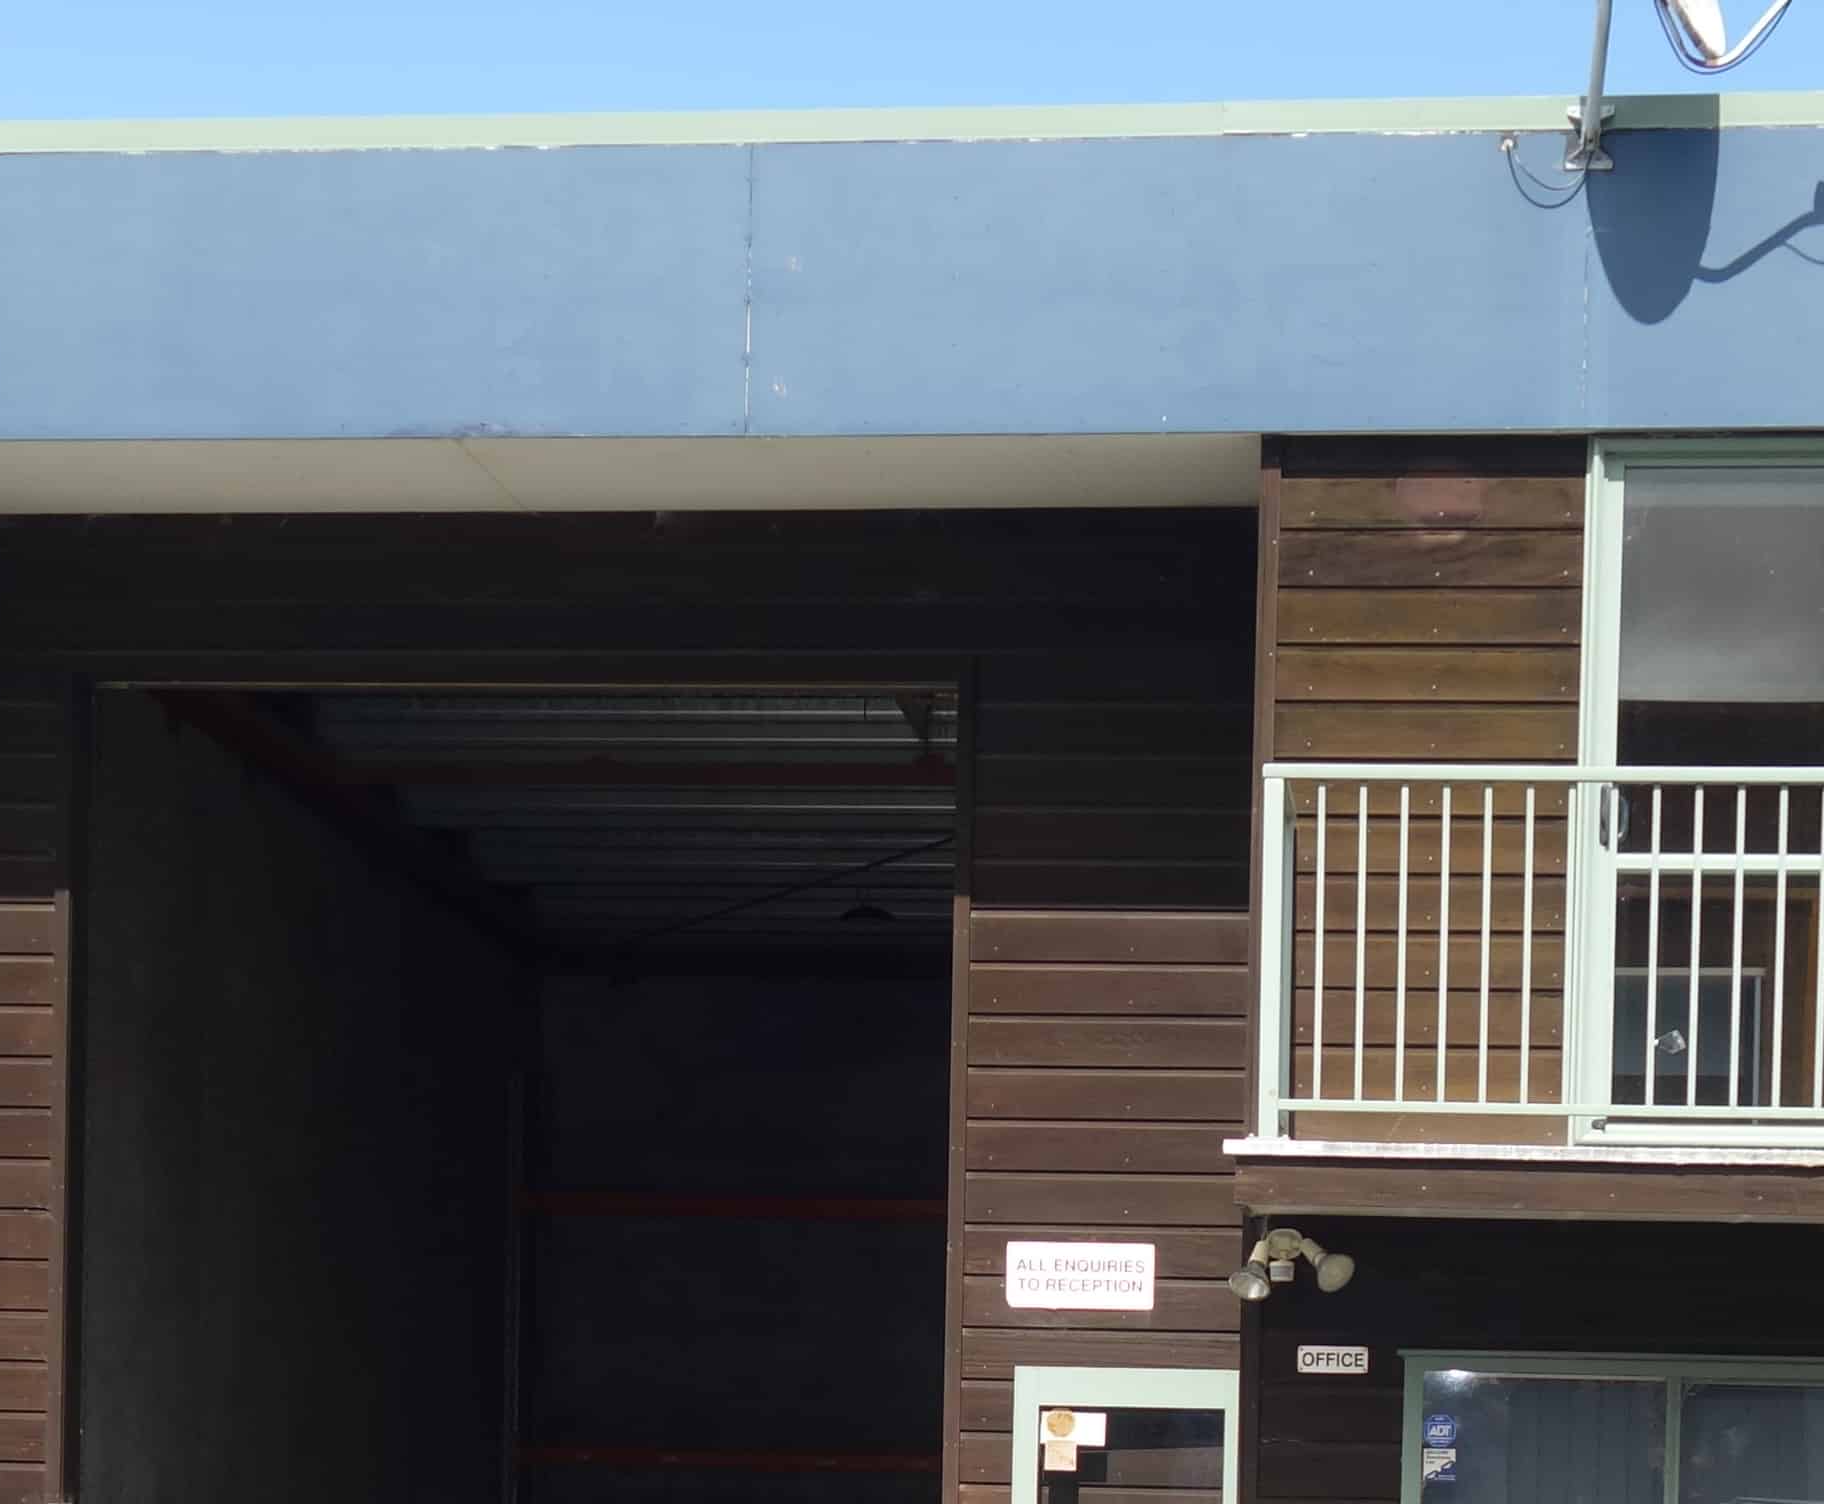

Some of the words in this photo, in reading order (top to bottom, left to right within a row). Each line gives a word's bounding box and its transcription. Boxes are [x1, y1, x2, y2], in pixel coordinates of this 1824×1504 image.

[1016, 1258, 1047, 1272] ALL
[1054, 1258, 1145, 1274] ENQUIRIES
[1018, 1278, 1040, 1291] TO
[1046, 1278, 1143, 1293] RECEPTION
[1302, 1351, 1365, 1369] OFFICE
[1429, 1424, 1451, 1437] ADT
